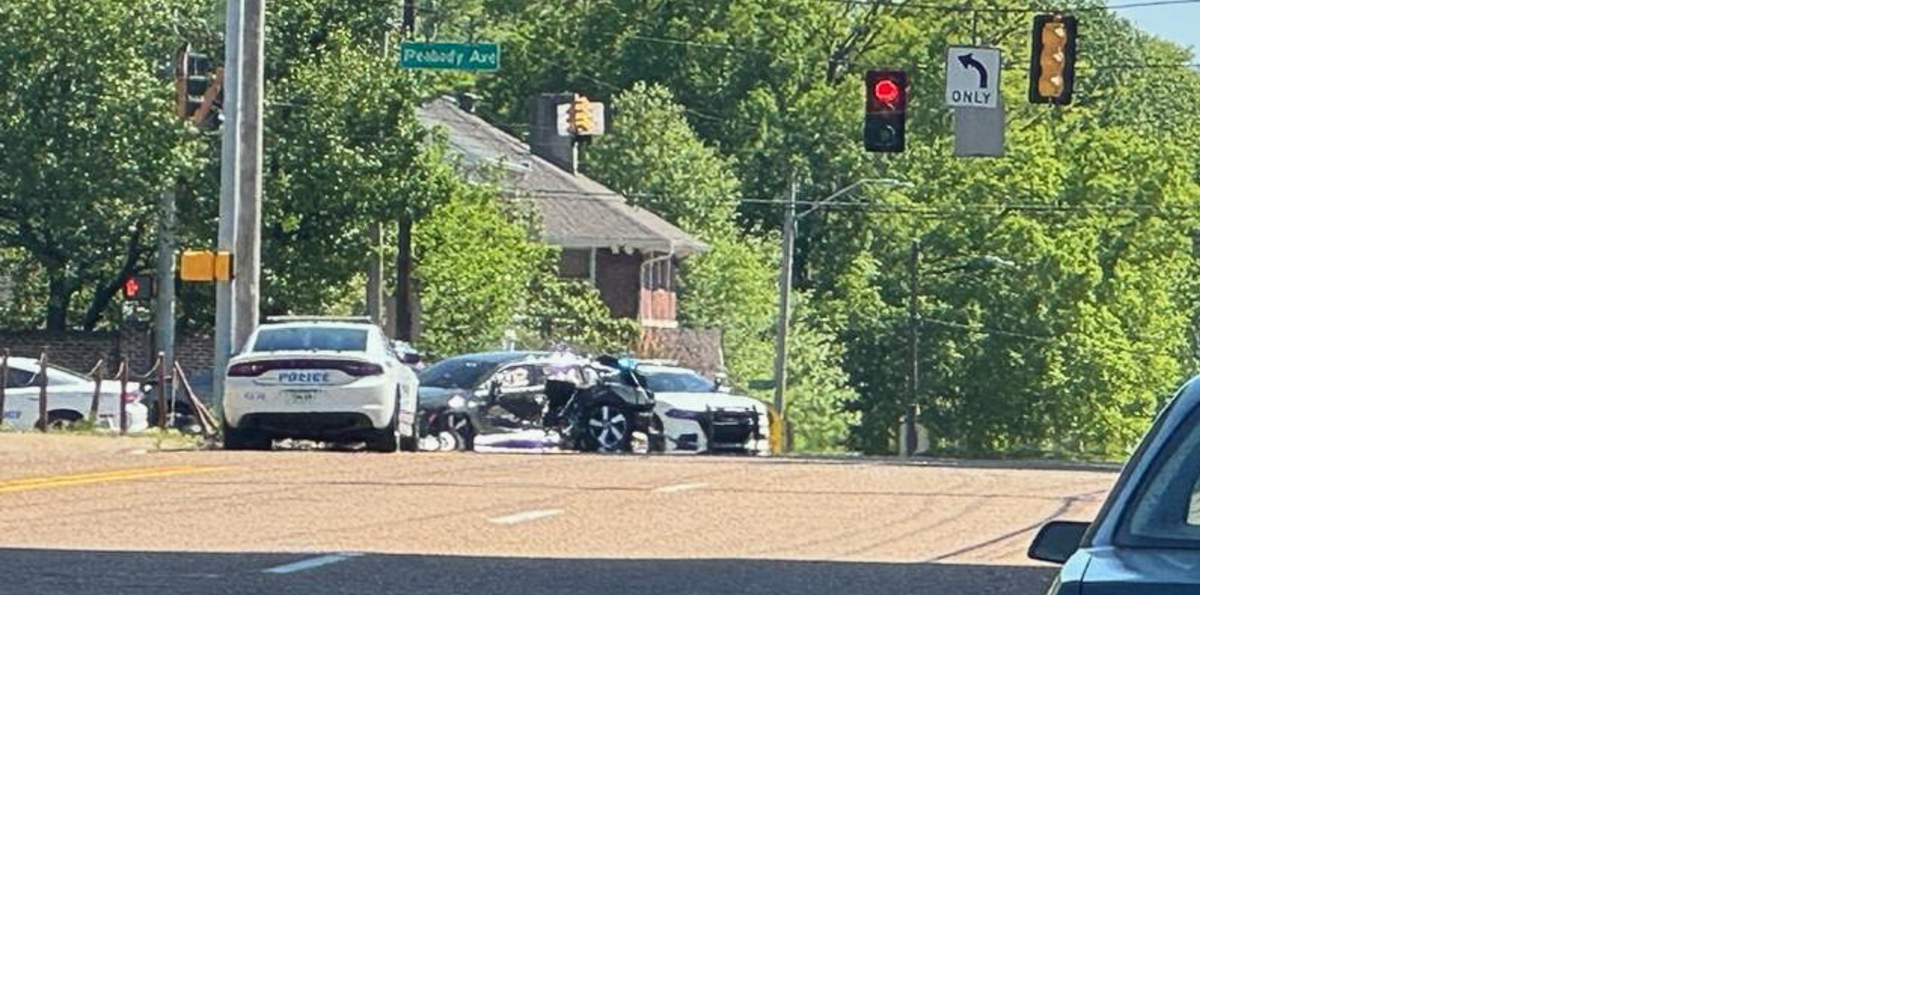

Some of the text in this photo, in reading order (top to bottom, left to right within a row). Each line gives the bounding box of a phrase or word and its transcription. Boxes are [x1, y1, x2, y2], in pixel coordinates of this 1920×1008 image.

[404, 49, 495, 66] Peabody Ave
[952, 91, 991, 104] ONLY
[279, 372, 330, 382] POLICE
